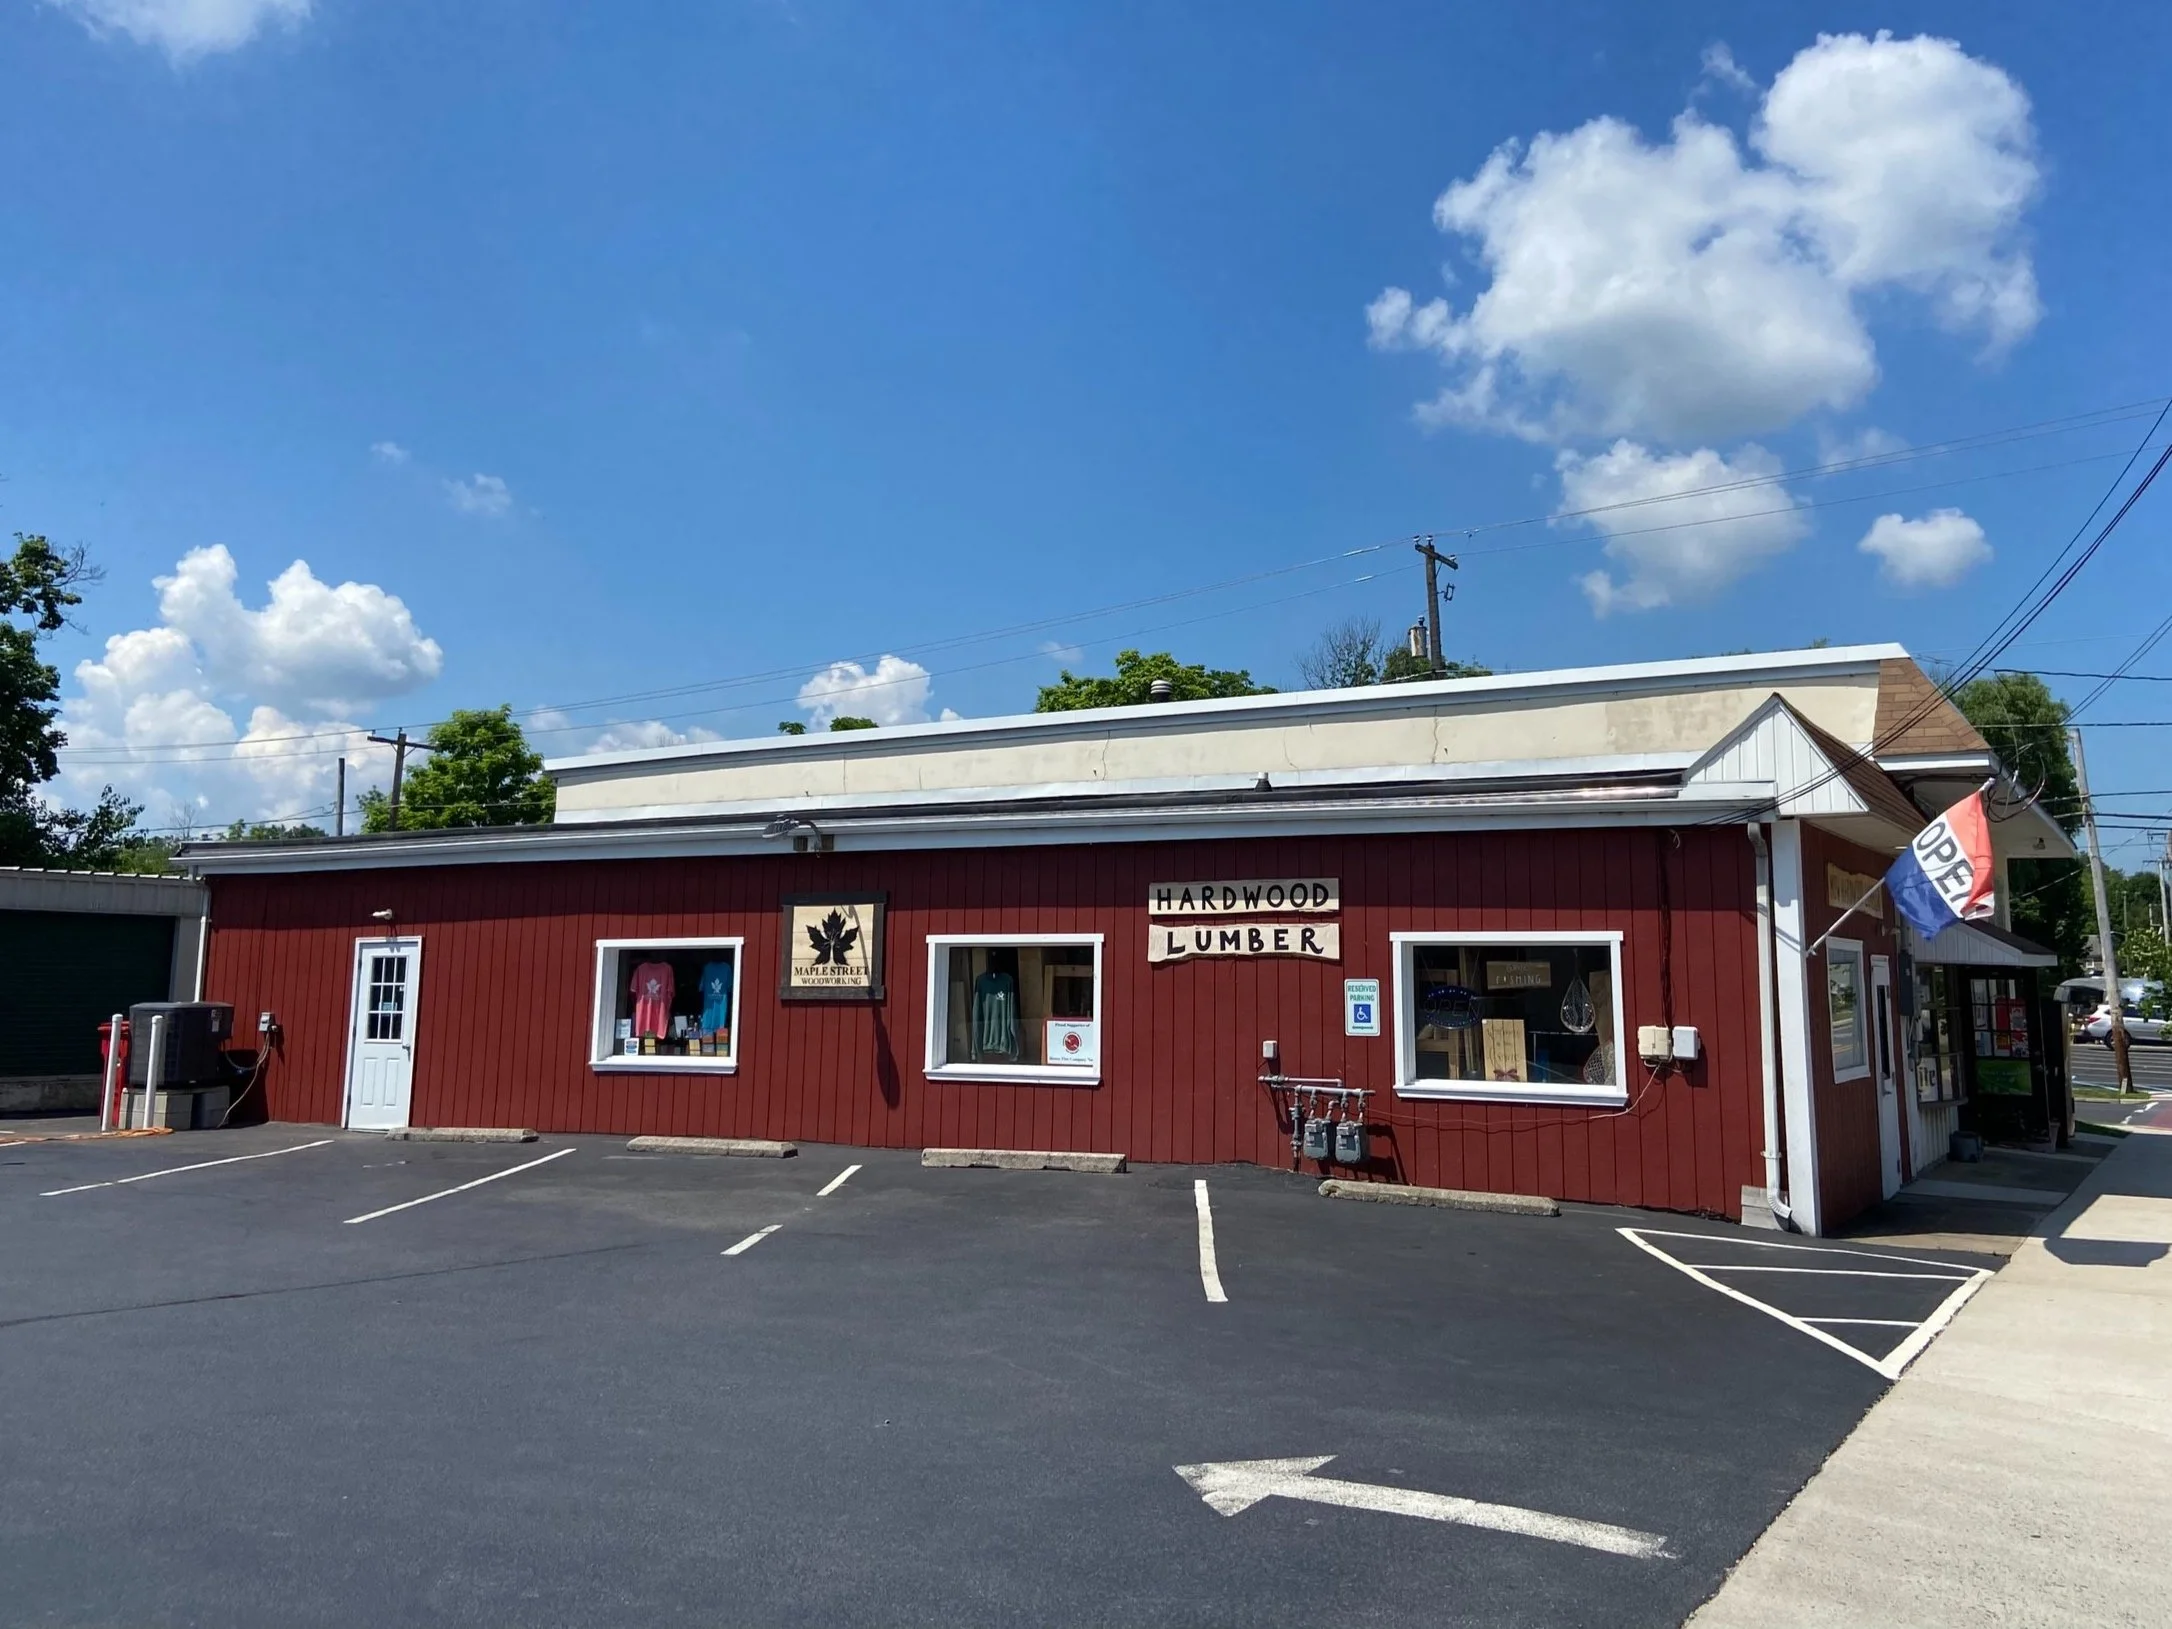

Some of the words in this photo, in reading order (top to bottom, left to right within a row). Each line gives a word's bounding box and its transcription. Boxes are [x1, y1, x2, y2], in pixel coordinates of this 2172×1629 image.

[1157, 883, 1329, 911] HARDWOOD
[1166, 928, 1324, 956] LUMBER
[794, 966, 828, 976] MAPLE
[830, 966, 868, 976] STREET
[801, 977, 862, 985] WOODWORKING
[1347, 984, 1377, 993] RESERVED
[1423, 998, 1480, 1019] OPEN
